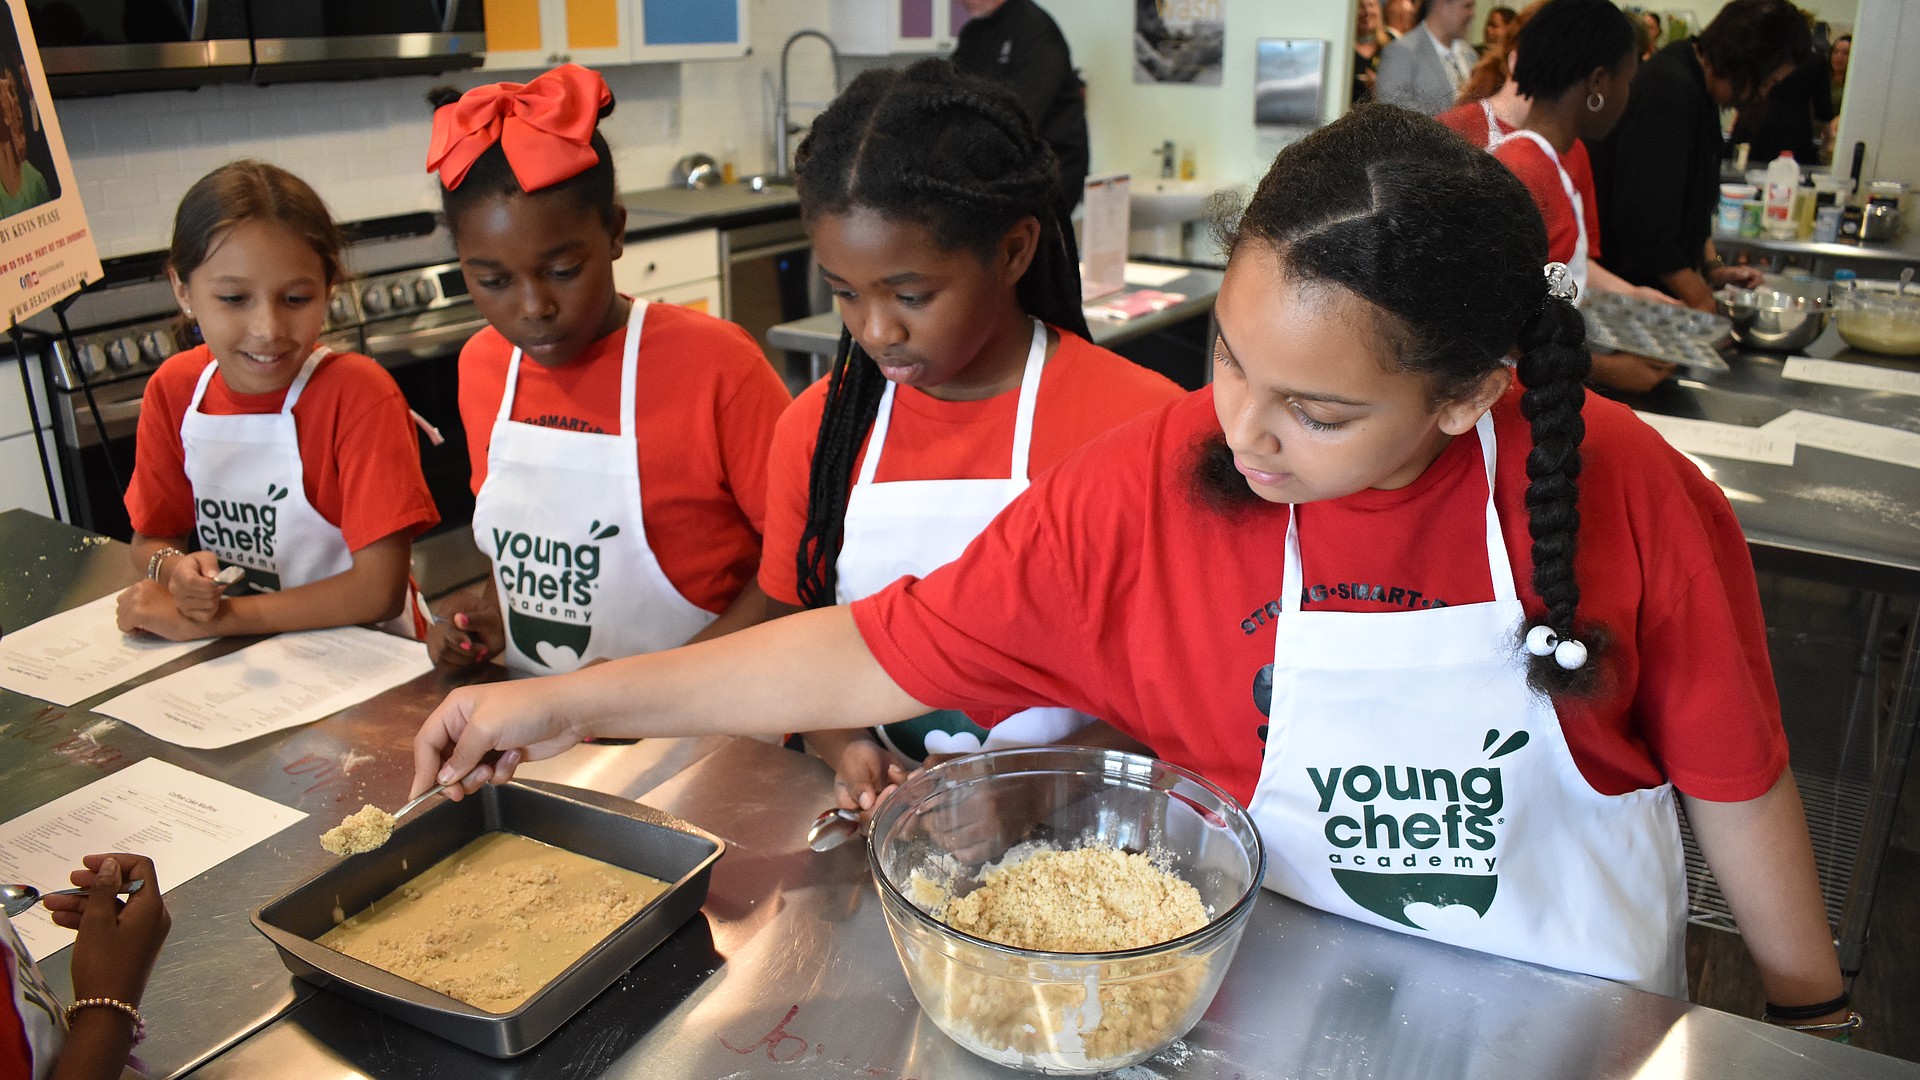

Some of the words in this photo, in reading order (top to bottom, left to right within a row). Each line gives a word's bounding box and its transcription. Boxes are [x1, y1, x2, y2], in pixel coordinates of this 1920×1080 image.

[0, 227, 11, 244] BY
[12, 218, 37, 238] KEVIN
[37, 208, 61, 228] PEASE
[540, 415, 589, 431] SMART
[200, 520, 275, 557] chefs
[492, 527, 600, 581] young
[500, 561, 592, 606] chefs
[510, 597, 592, 622] cademy
[1240, 584, 1329, 635] STRNG
[1338, 582, 1423, 609] SMART
[1306, 765, 1504, 817] young
[1324, 804, 1497, 851] chefs
[1329, 853, 1497, 872] academy
